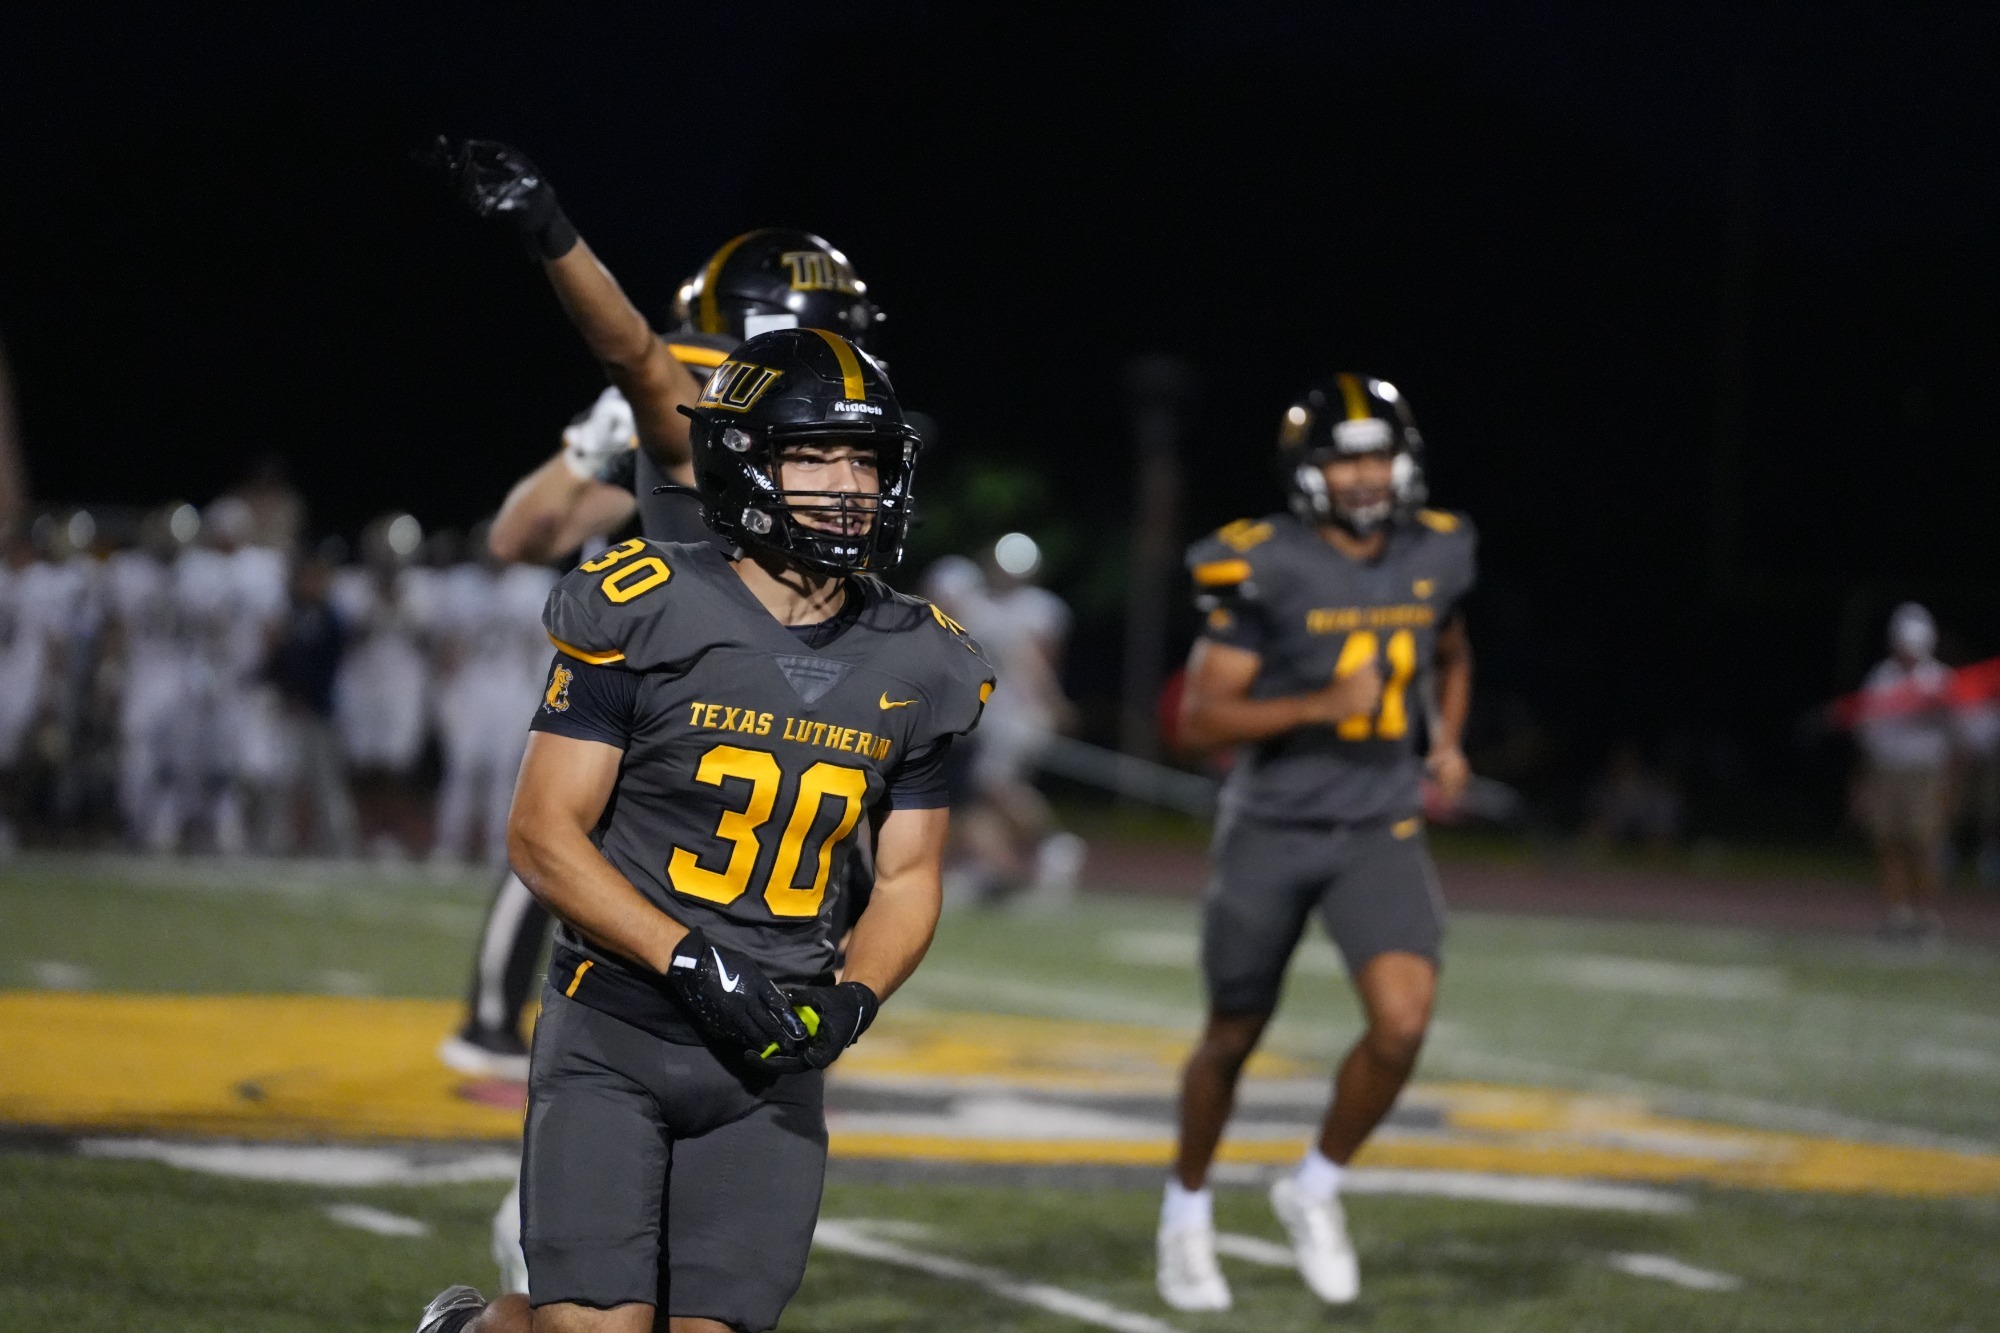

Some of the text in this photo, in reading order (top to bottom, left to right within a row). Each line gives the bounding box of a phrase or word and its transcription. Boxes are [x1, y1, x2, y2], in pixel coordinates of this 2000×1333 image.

[579, 538, 671, 603] 30
[689, 702, 774, 736] TEXAS
[667, 744, 868, 918] 30
